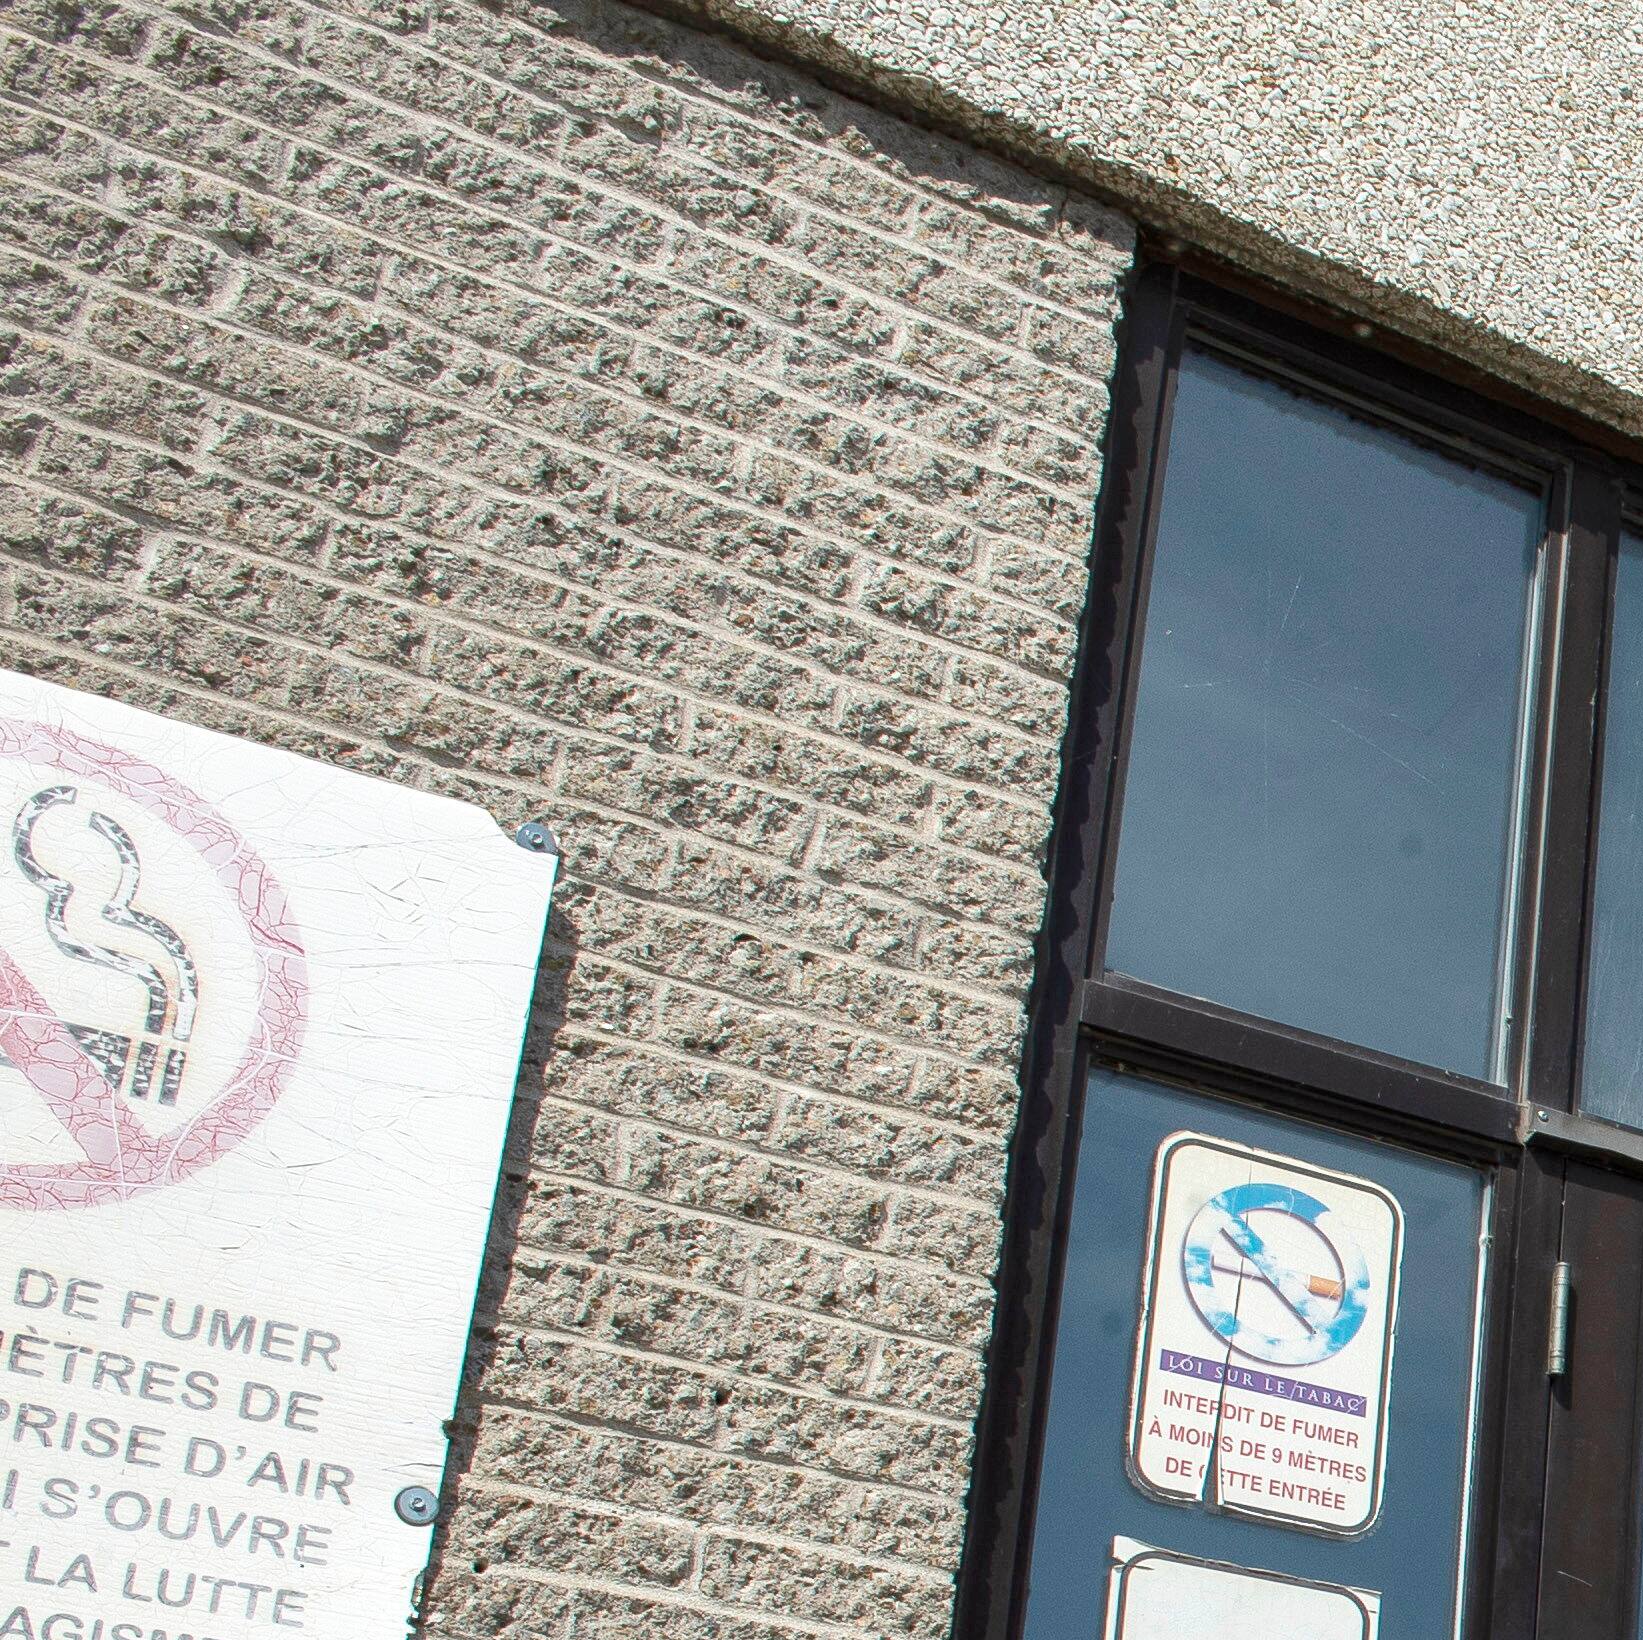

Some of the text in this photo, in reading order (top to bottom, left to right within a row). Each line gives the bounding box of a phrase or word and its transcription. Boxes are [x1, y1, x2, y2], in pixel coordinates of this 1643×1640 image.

[14, 1267, 341, 1371] DE FUMER
[0, 1325, 323, 1432] ÈTRES DE
[1168, 1354, 1359, 1411] LOI SUR LE TABAC
[1148, 1414, 1162, 1437] À
[1240, 1439, 1266, 1460] DE
[1272, 1447, 1282, 1463] 9
[1287, 1448, 1367, 1483] MÈTRES
[1260, 1412, 1286, 1431] DE
[1292, 1420, 1359, 1448] FUMER
[184, 1437, 355, 1505] D'AIR
[1165, 1456, 1346, 1511] DE ENTRÉE
[39, 1478, 332, 1565] S'OUVRE
[25, 1545, 308, 1628] LA LUTTE
